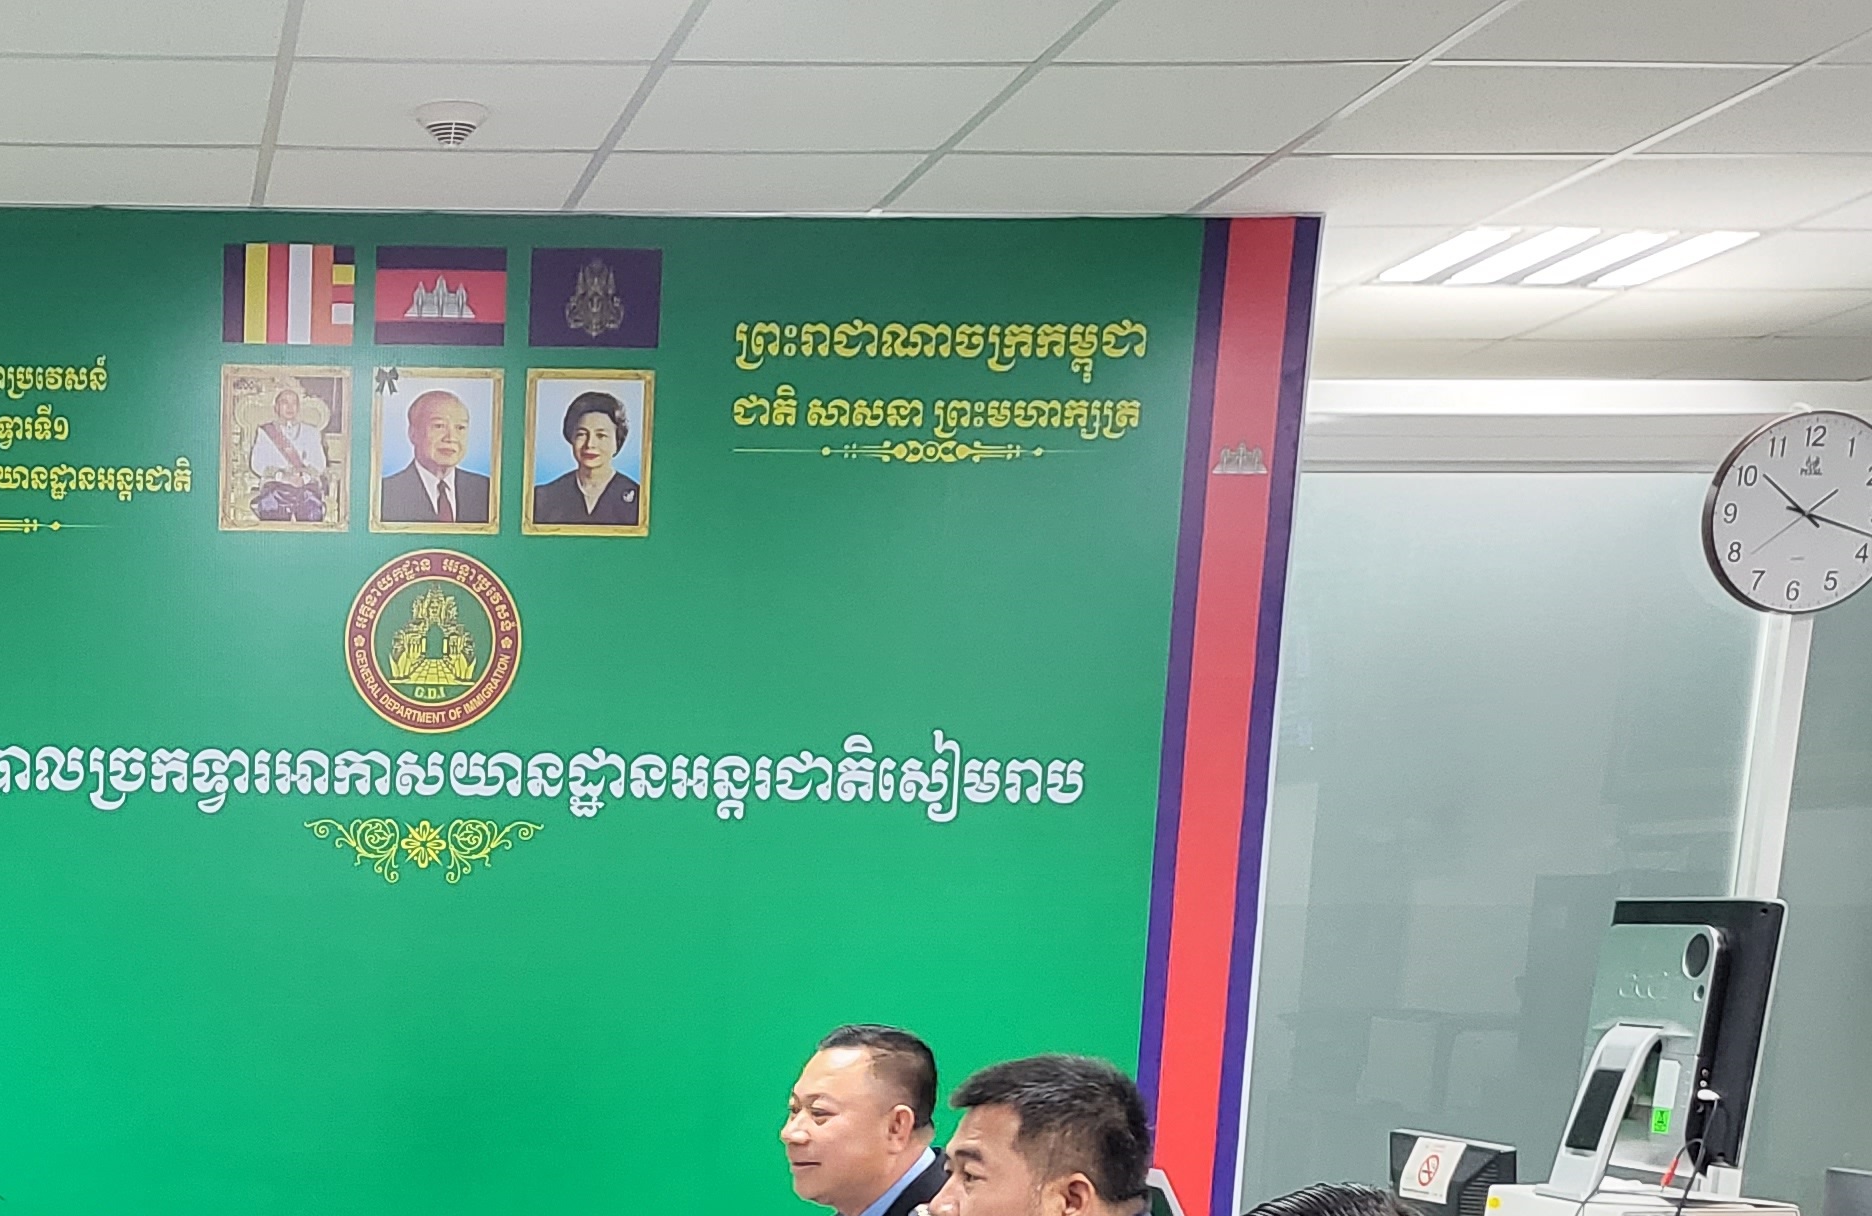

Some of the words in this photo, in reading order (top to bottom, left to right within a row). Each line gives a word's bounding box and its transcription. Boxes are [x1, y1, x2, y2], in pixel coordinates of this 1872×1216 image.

[735, 319, 1147, 383] ព្រះរាជាណាចក្រកម្ពុជា
[733, 384, 797, 427] ជាតិ
[807, 398, 924, 428] សាសនា
[933, 399, 1141, 440] ព្រះមហាក្សត្រ
[1769, 436, 1787, 458] 11
[1805, 425, 1827, 447] 12
[1848, 436, 1856, 458] 1
[1736, 465, 1758, 487] 10
[1723, 502, 1738, 524] 9
[1727, 541, 1742, 563] 8
[1854, 542, 1869, 564] 4
[1751, 569, 1766, 592] 7
[1785, 580, 1801, 601] 6
[1823, 570, 1839, 592] 5
[355, 649, 383, 699] GENERAL
[379, 692, 447, 725] DEPARTMENT
[448, 707, 464, 721] OF
[463, 653, 512, 716] IMMIGRATION
